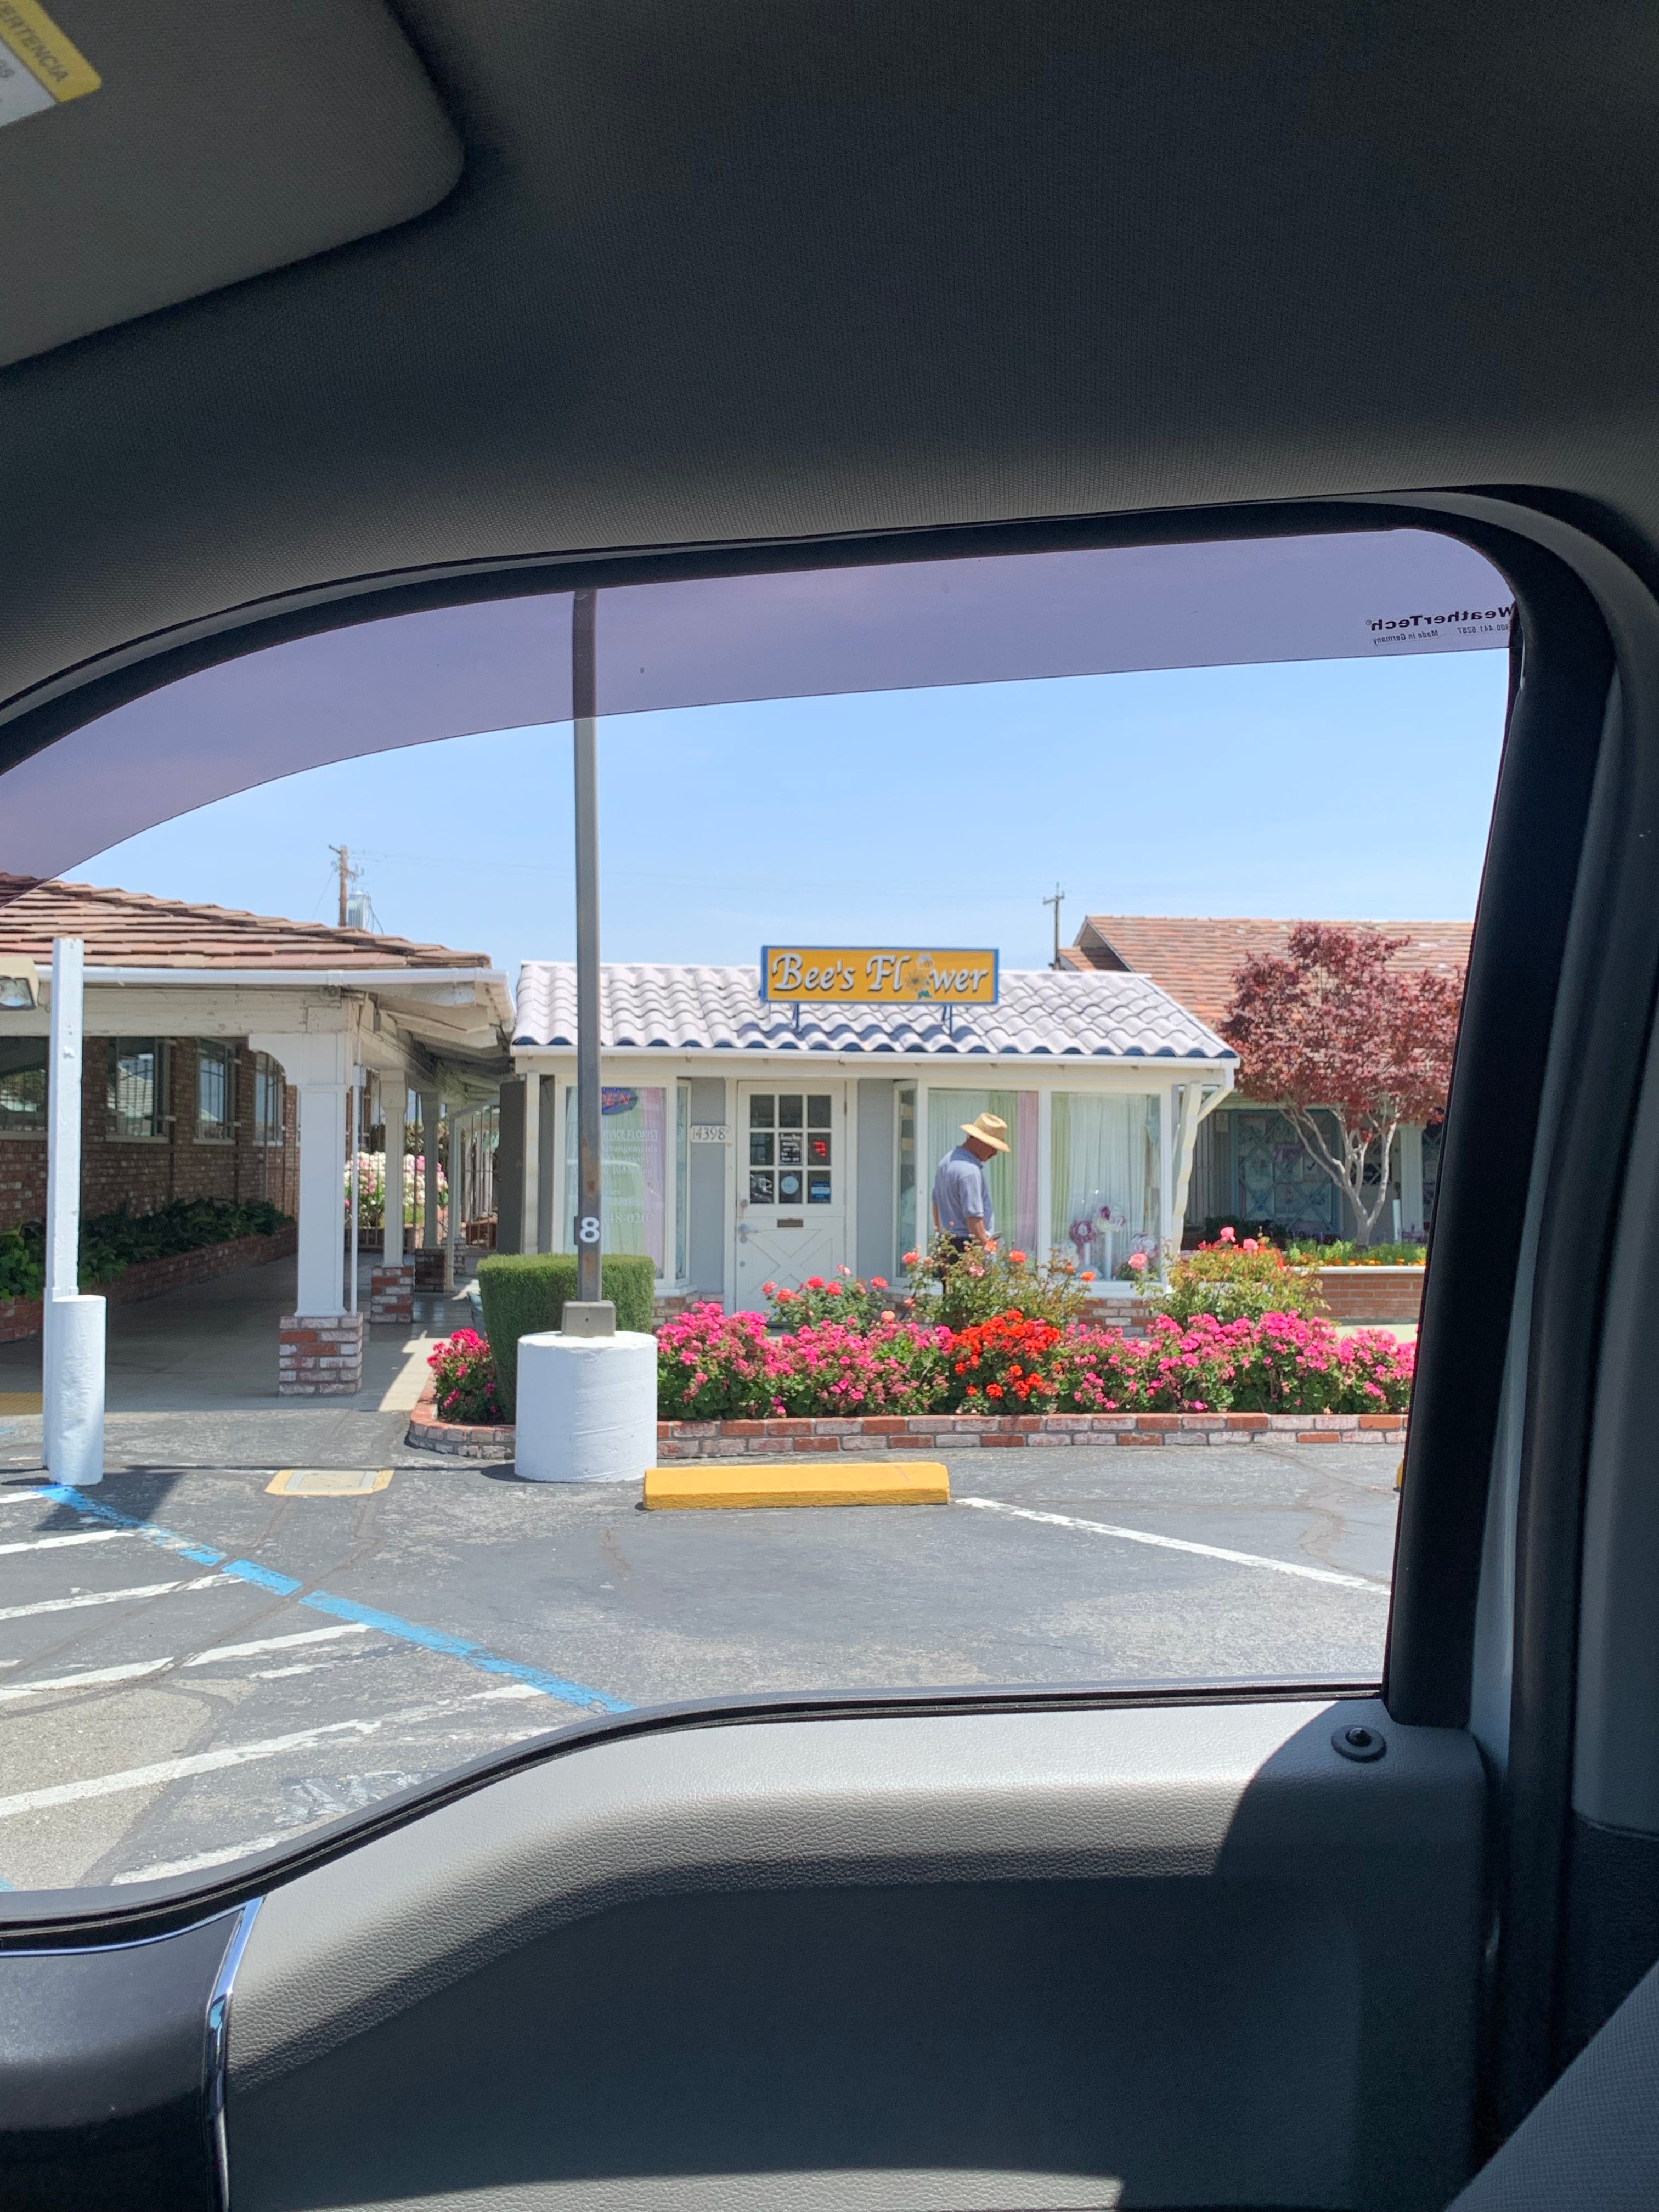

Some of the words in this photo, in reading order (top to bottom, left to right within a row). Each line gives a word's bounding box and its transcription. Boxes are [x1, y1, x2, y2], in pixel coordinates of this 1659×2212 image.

[772, 953, 856, 991] Bee's
[627, 1128, 659, 1139] FLORIST
[692, 1126, 726, 1141] 14398
[579, 1216, 600, 1243] 8
